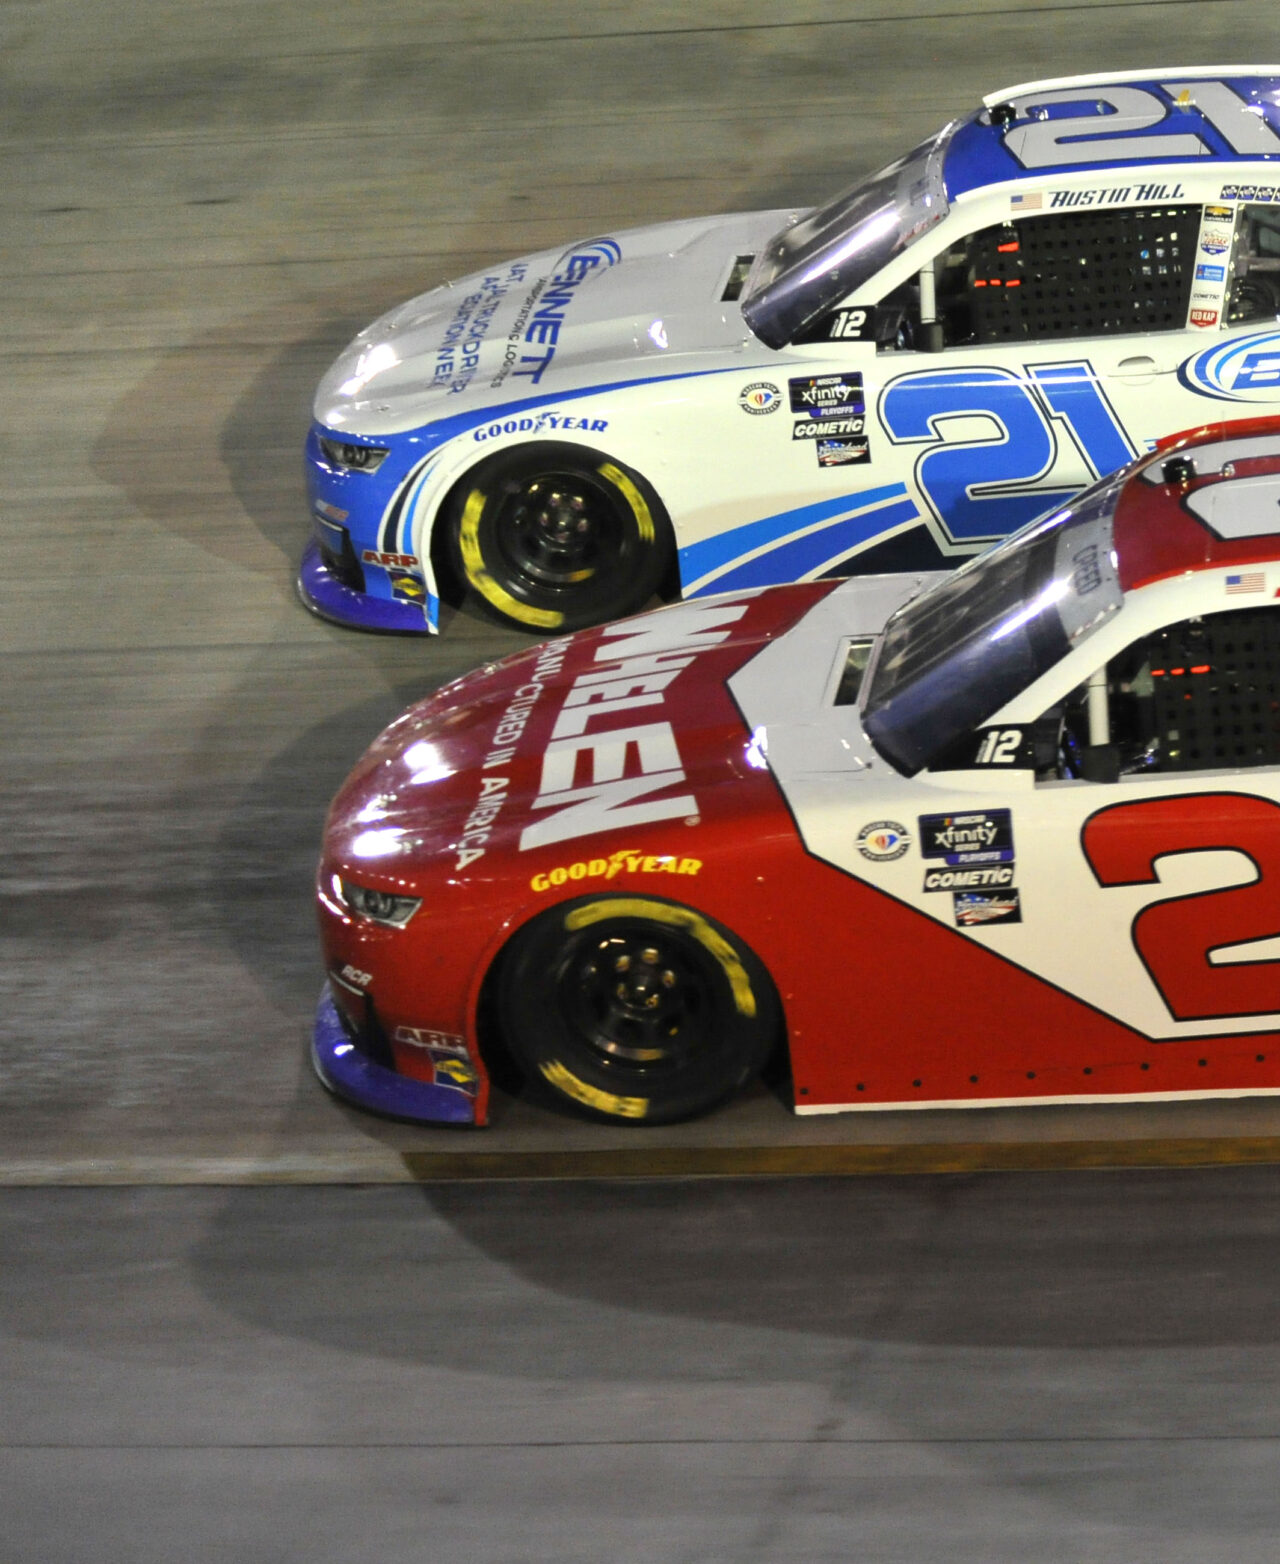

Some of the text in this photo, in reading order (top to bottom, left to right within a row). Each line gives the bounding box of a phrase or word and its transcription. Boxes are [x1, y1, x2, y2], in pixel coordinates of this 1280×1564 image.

[1048, 183, 1185, 208] AUSTIN HILL
[833, 310, 867, 338] 12
[1191, 311, 1216, 321] RED KAP
[802, 386, 852, 405] xfinity
[820, 406, 854, 416] PLAYOFFS
[473, 413, 609, 442] GOODYEAR
[794, 419, 864, 437] COMETIC
[876, 359, 1140, 547] 21
[363, 550, 419, 568] ARP
[518, 600, 749, 851] WHELEN
[482, 747, 517, 769] IN
[980, 730, 1022, 764] 12
[455, 777, 510, 871] AMERICA
[934, 825, 998, 849] xfinity
[530, 850, 702, 892] GOODYEAR
[925, 867, 1013, 889] COMETIC
